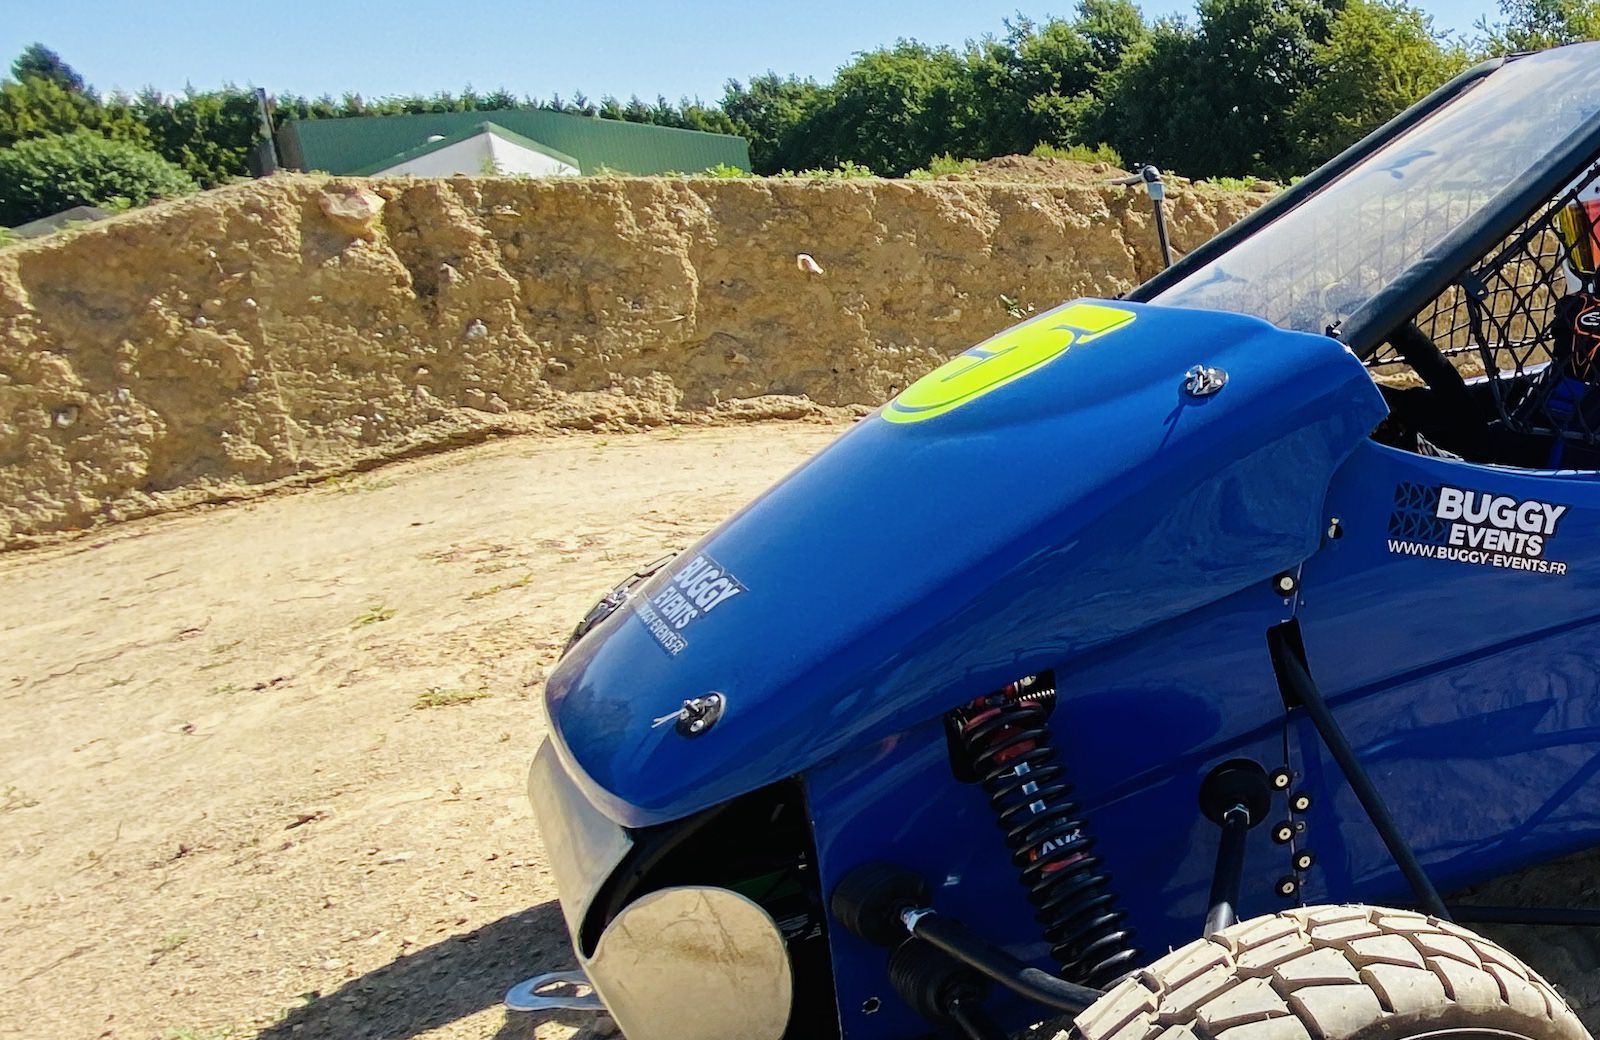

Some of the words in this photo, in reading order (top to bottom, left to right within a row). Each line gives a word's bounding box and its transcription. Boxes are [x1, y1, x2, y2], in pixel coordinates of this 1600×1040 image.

[1436, 486, 1566, 535] BUGGY
[1387, 539, 1567, 575] WWW.BUGGY-EVENTS.FR
[1448, 522, 1544, 557] EVENTS
[673, 556, 740, 613] BUGGY
[653, 585, 698, 630] EVENTS
